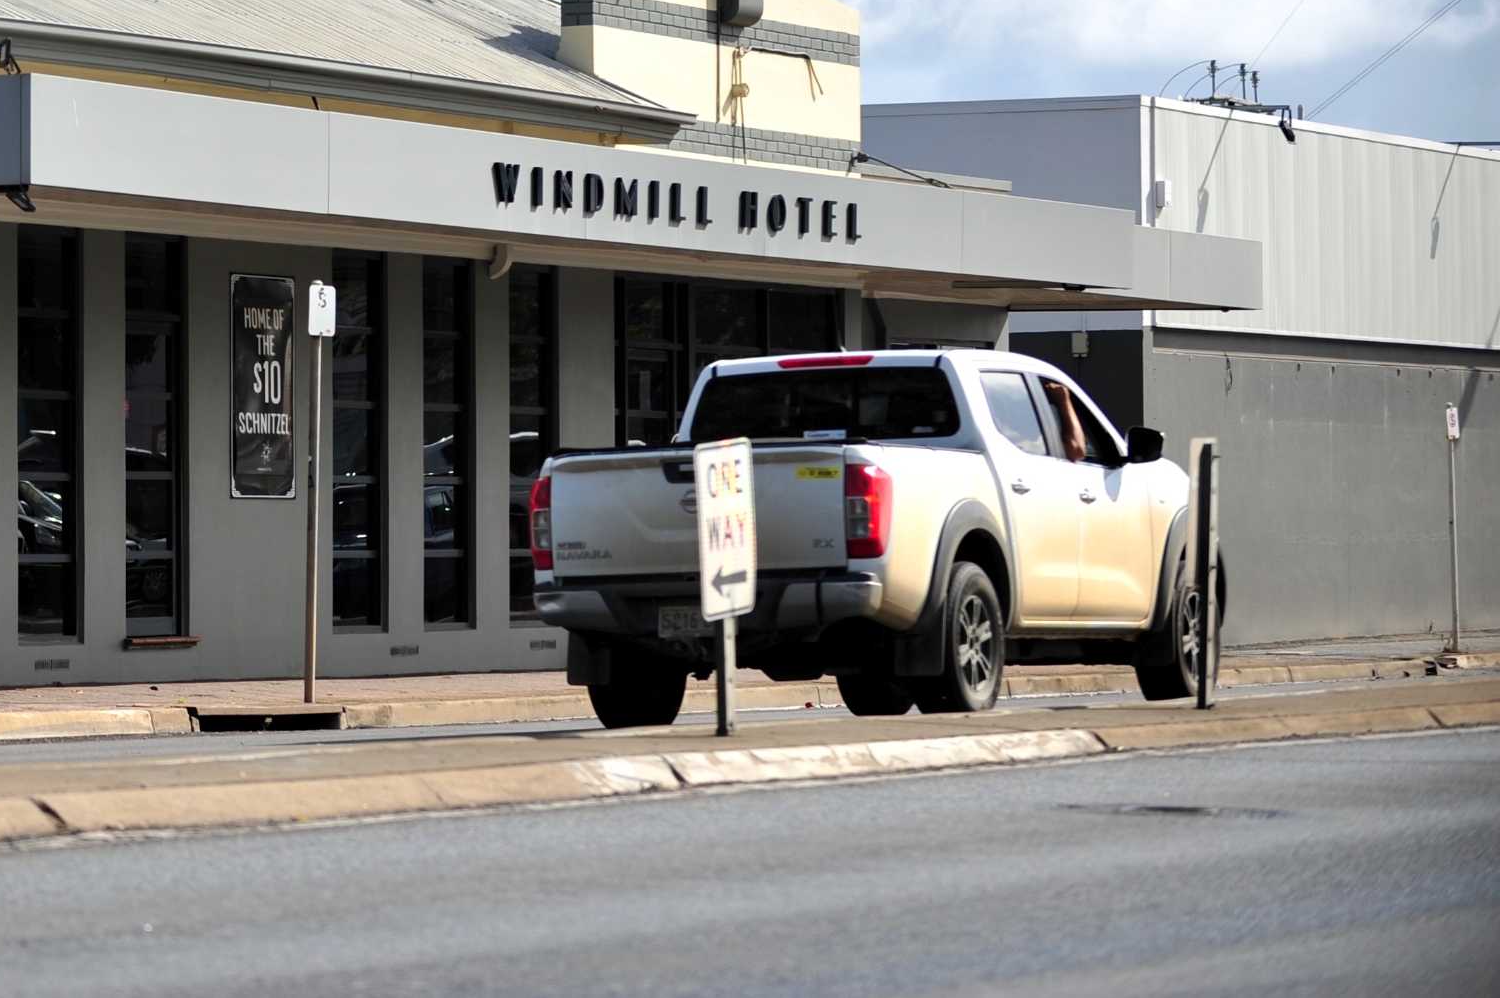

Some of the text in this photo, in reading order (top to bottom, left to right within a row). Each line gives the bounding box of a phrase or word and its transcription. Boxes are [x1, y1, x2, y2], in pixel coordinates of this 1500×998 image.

[491, 162, 862, 241] WINDMILL HOTEL
[243, 307, 285, 330] HOME OF
[256, 334, 276, 356] THE
[238, 412, 290, 434] SCHNITZEL
